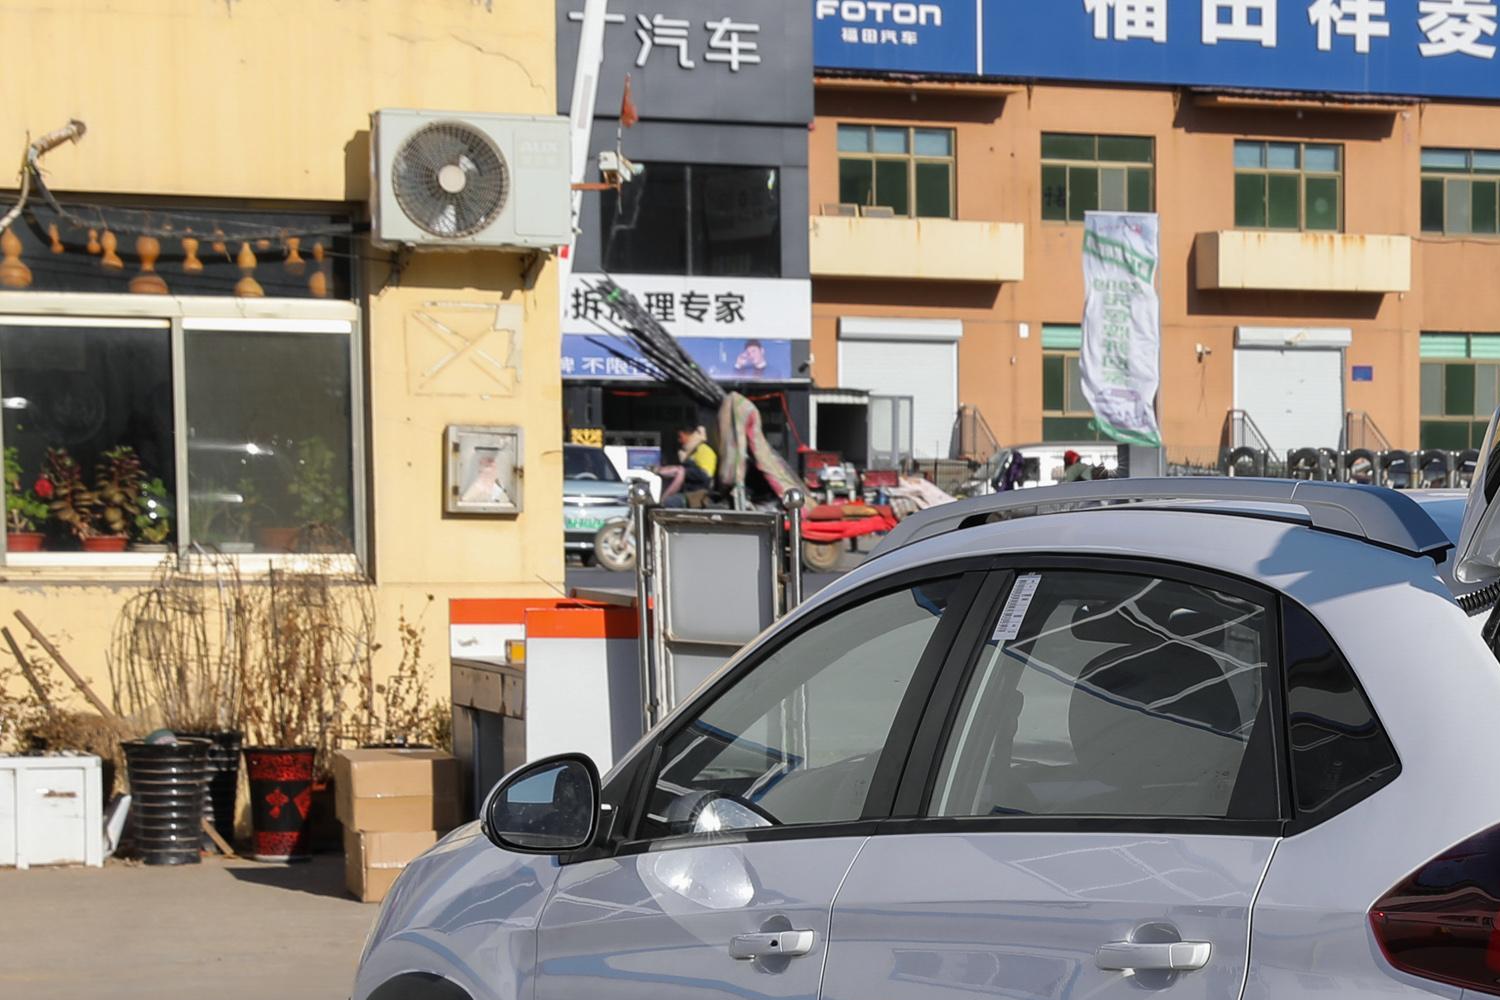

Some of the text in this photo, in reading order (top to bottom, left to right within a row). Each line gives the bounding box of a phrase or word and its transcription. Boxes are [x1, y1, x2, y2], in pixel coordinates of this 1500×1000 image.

[816, 0, 943, 26] FOTON
[841, 27, 918, 46] 福田汽车
